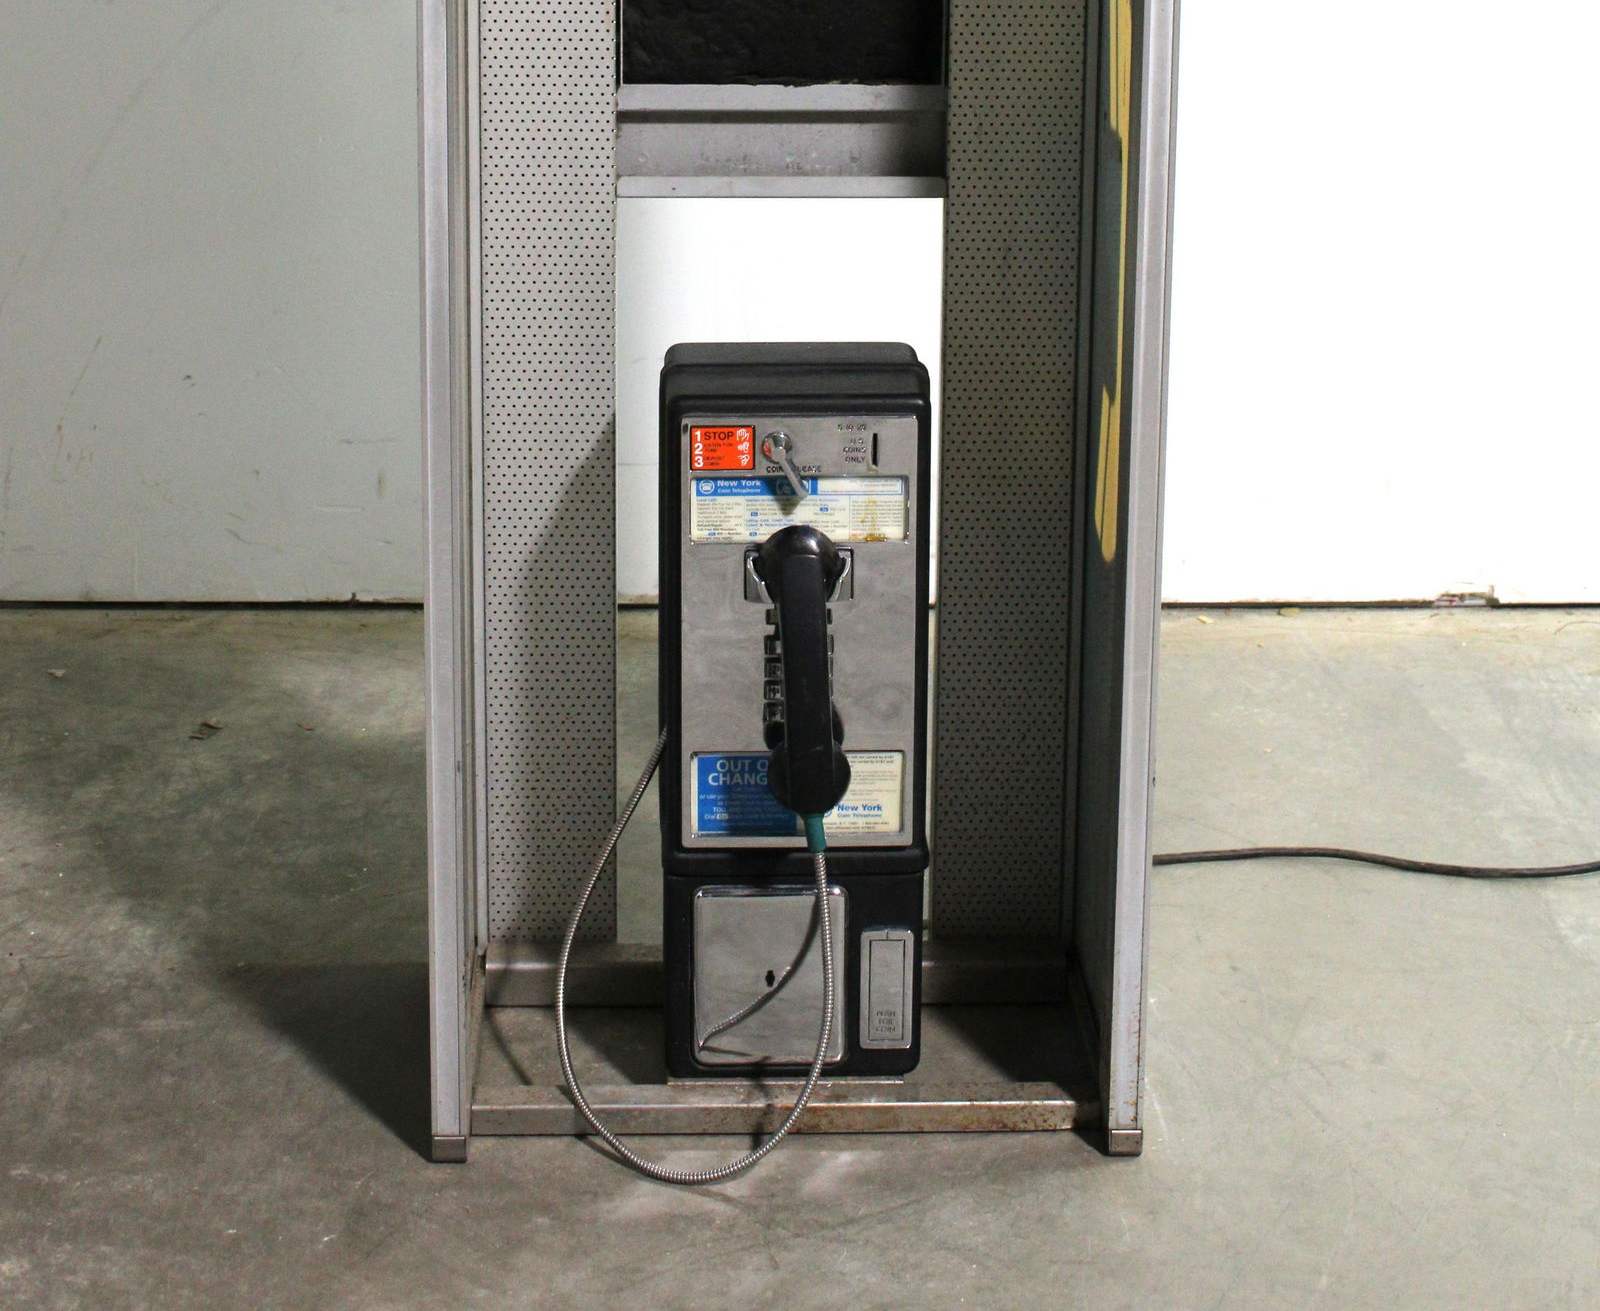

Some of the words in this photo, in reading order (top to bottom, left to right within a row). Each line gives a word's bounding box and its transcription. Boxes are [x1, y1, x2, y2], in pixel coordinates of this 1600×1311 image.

[694, 430, 701, 442] 1
[704, 431, 734, 441] STOP
[694, 443, 703, 455] 2
[694, 455, 704, 467] 3
[845, 456, 866, 464] ONLY
[717, 479, 738, 487] New
[741, 479, 762, 487] York
[716, 759, 752, 772] OUT
[757, 759, 768, 772] O
[708, 773, 768, 786] CHANG
[837, 803, 858, 812] New
[861, 803, 882, 812] York
